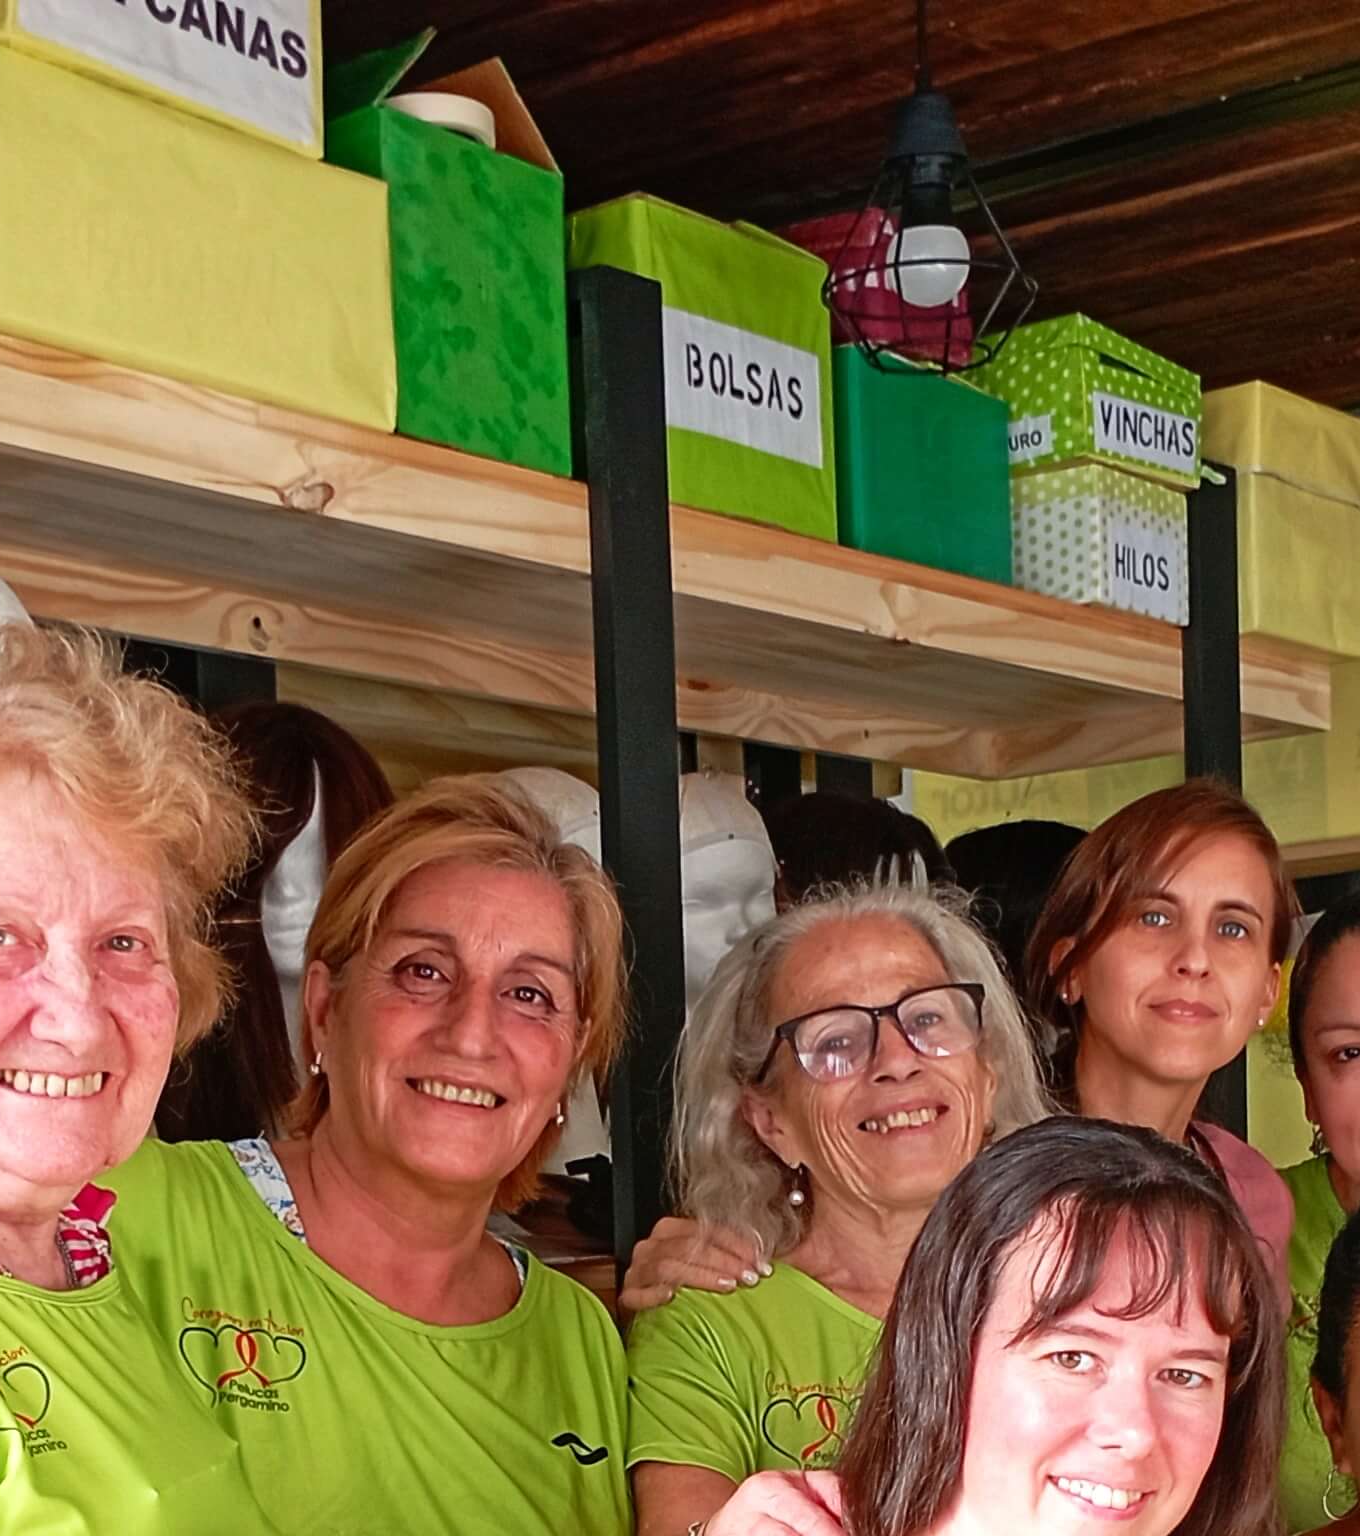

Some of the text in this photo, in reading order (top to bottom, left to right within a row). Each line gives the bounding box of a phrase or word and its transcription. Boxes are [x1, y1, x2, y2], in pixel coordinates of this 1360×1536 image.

[686, 342, 803, 420] BOLSAS
[1100, 400, 1194, 457] VINCHAS
[1115, 543, 1170, 591] HILOS
[229, 1379, 279, 1399] Pelucas
